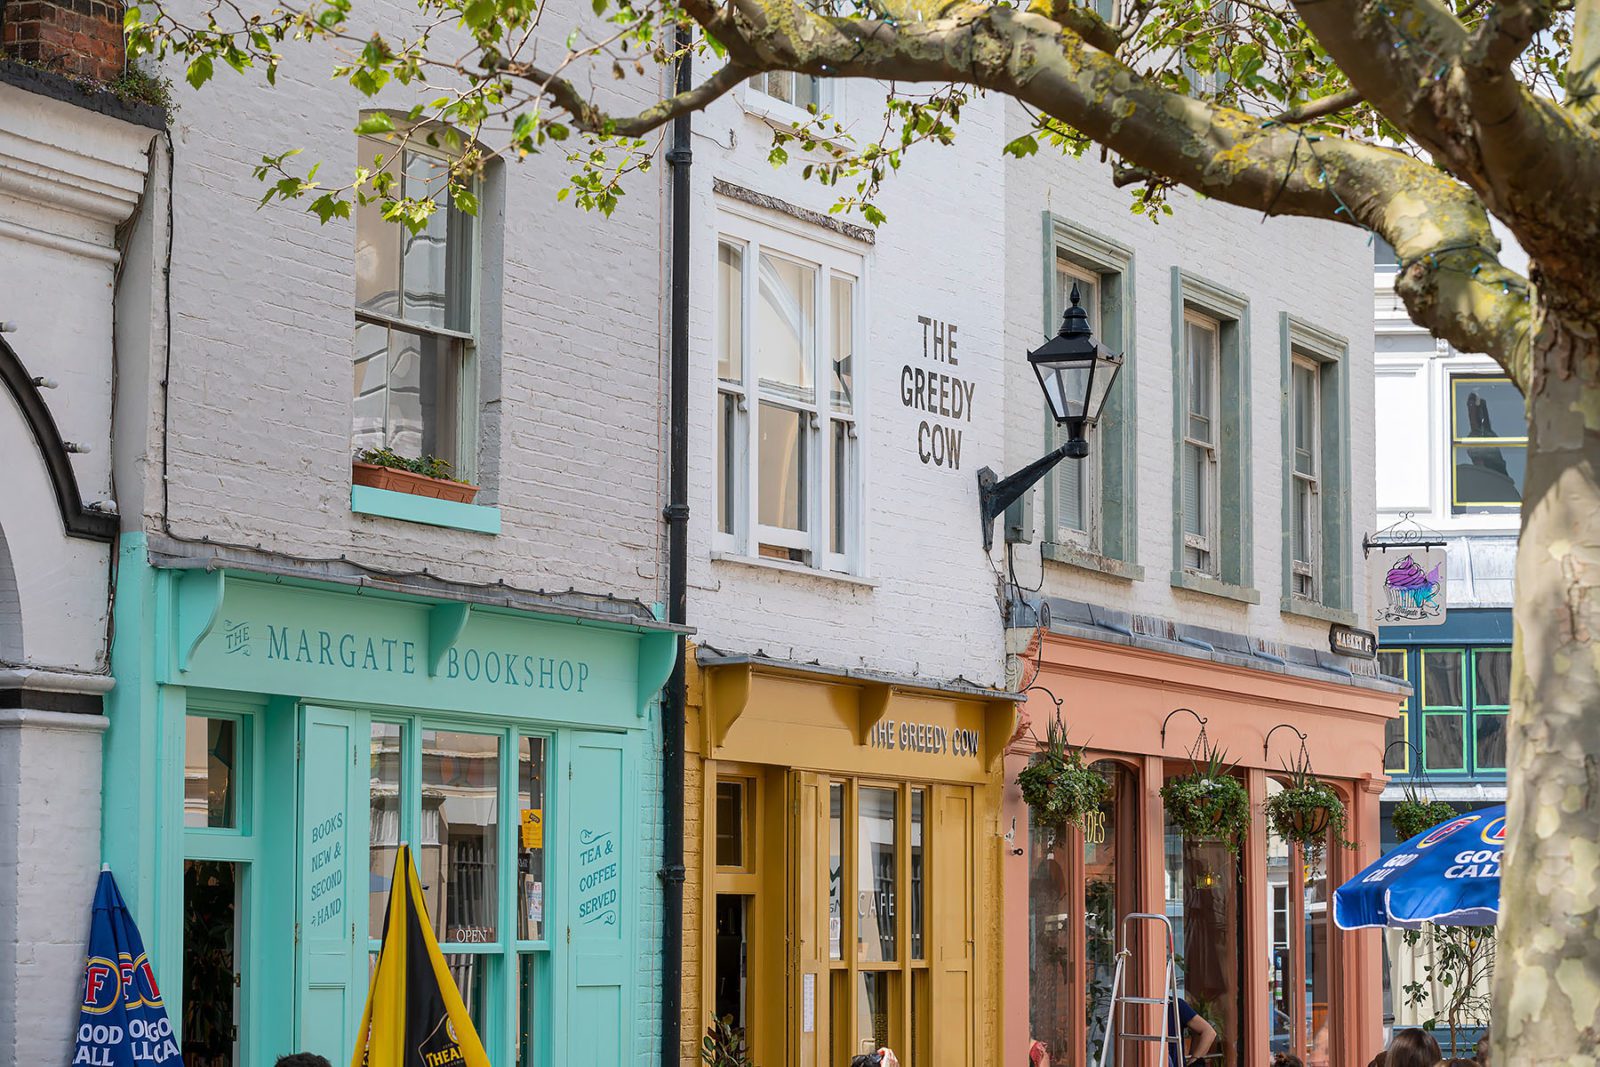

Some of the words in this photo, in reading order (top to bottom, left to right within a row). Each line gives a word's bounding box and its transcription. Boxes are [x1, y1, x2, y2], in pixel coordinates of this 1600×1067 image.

[917, 315, 958, 366] THE
[900, 364, 976, 423] GREEDY
[918, 420, 962, 470] COW
[1336, 631, 1363, 650] MARKET
[225, 626, 250, 649] THE
[267, 624, 415, 675] MARGATE
[447, 647, 589, 693] BOOKSHOP
[899, 721, 948, 753] GREEDY
[953, 728, 979, 757] COW
[312, 812, 343, 843] BOOKS
[312, 846, 332, 872] NEW
[333, 841, 342, 859] &
[580, 845, 602, 866] TEA
[604, 839, 613, 855] &
[311, 869, 342, 901] SECOND
[579, 863, 617, 892] COFFEE
[317, 898, 342, 927] HAND
[579, 889, 617, 918] SERVED
[858, 892, 895, 917] CAFE
[456, 928, 488, 943] OPEN
[77, 1023, 124, 1045] OOD
[72, 1045, 114, 1067] ALL
